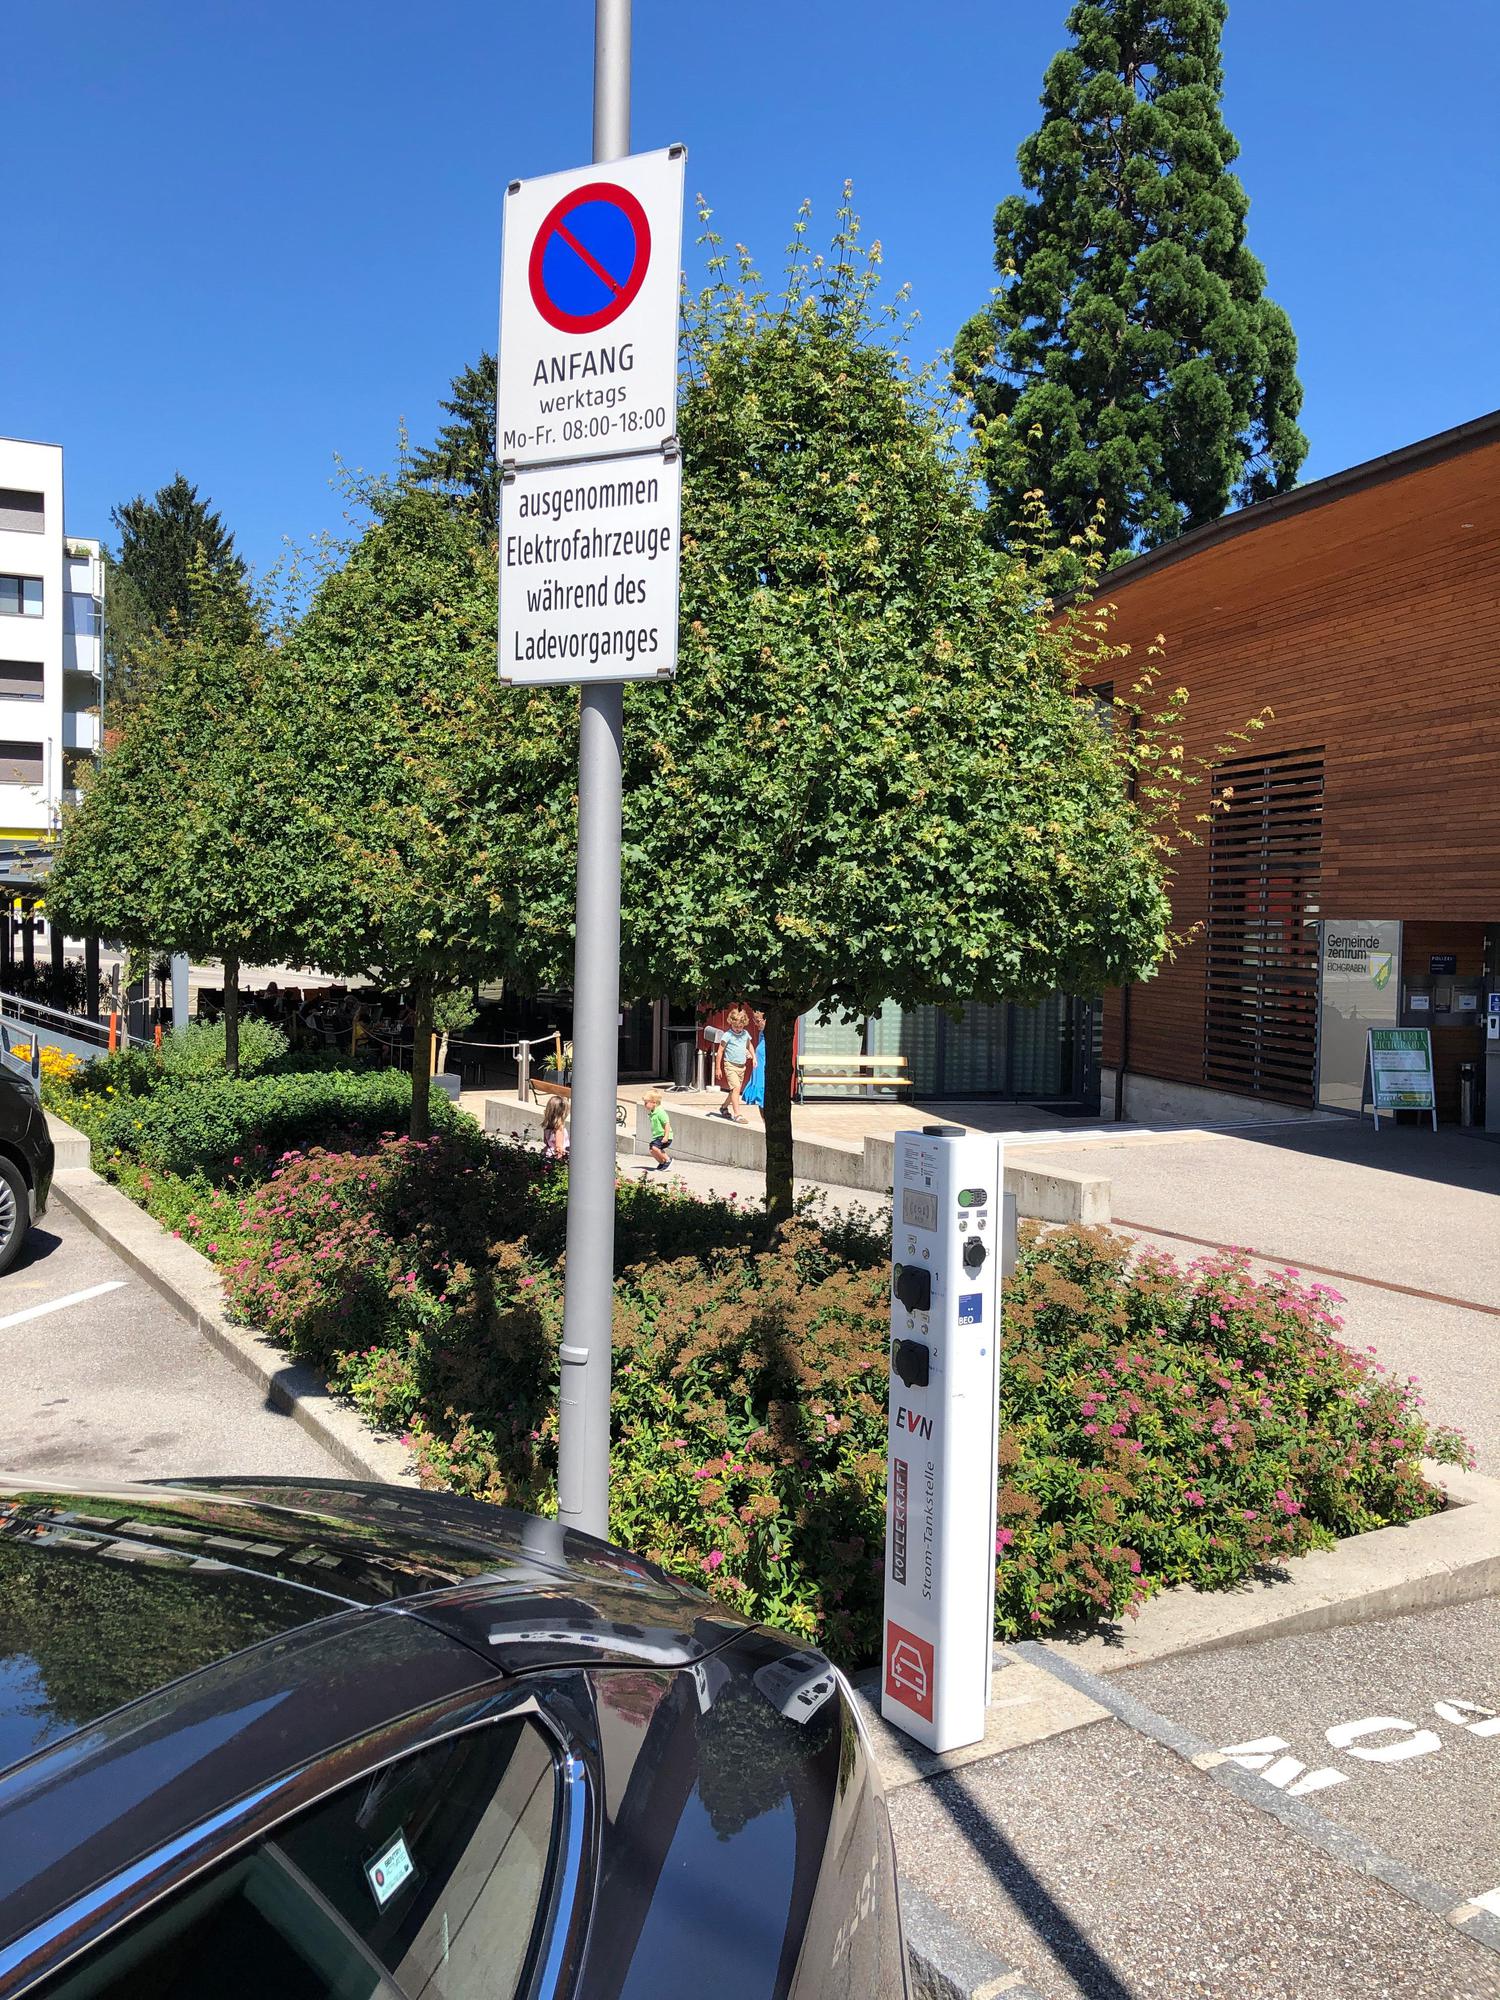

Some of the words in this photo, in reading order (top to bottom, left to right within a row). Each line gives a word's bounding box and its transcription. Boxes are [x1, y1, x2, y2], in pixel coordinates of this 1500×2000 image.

[533, 343, 634, 387] ANFANG
[540, 385, 627, 415] werktags
[503, 425, 556, 451] Mo-Fr.
[563, 406, 666, 442] 08:00-18:00
[519, 477, 658, 522] ausgenommen
[507, 525, 671, 567] Elektrofahrzeuge
[527, 575, 608, 613] während
[614, 573, 647, 605] des
[515, 626, 659, 664] Ladevorganges
[1327, 934, 1380, 949] Gemeinde
[1328, 946, 1367, 960] zentrum
[1327, 962, 1367, 973] EICHGRABEN
[895, 1406, 934, 1441] EVN
[894, 1461, 907, 1580] VOLLEKRAFT
[921, 1461, 935, 1600] Strom-Tankstelle
